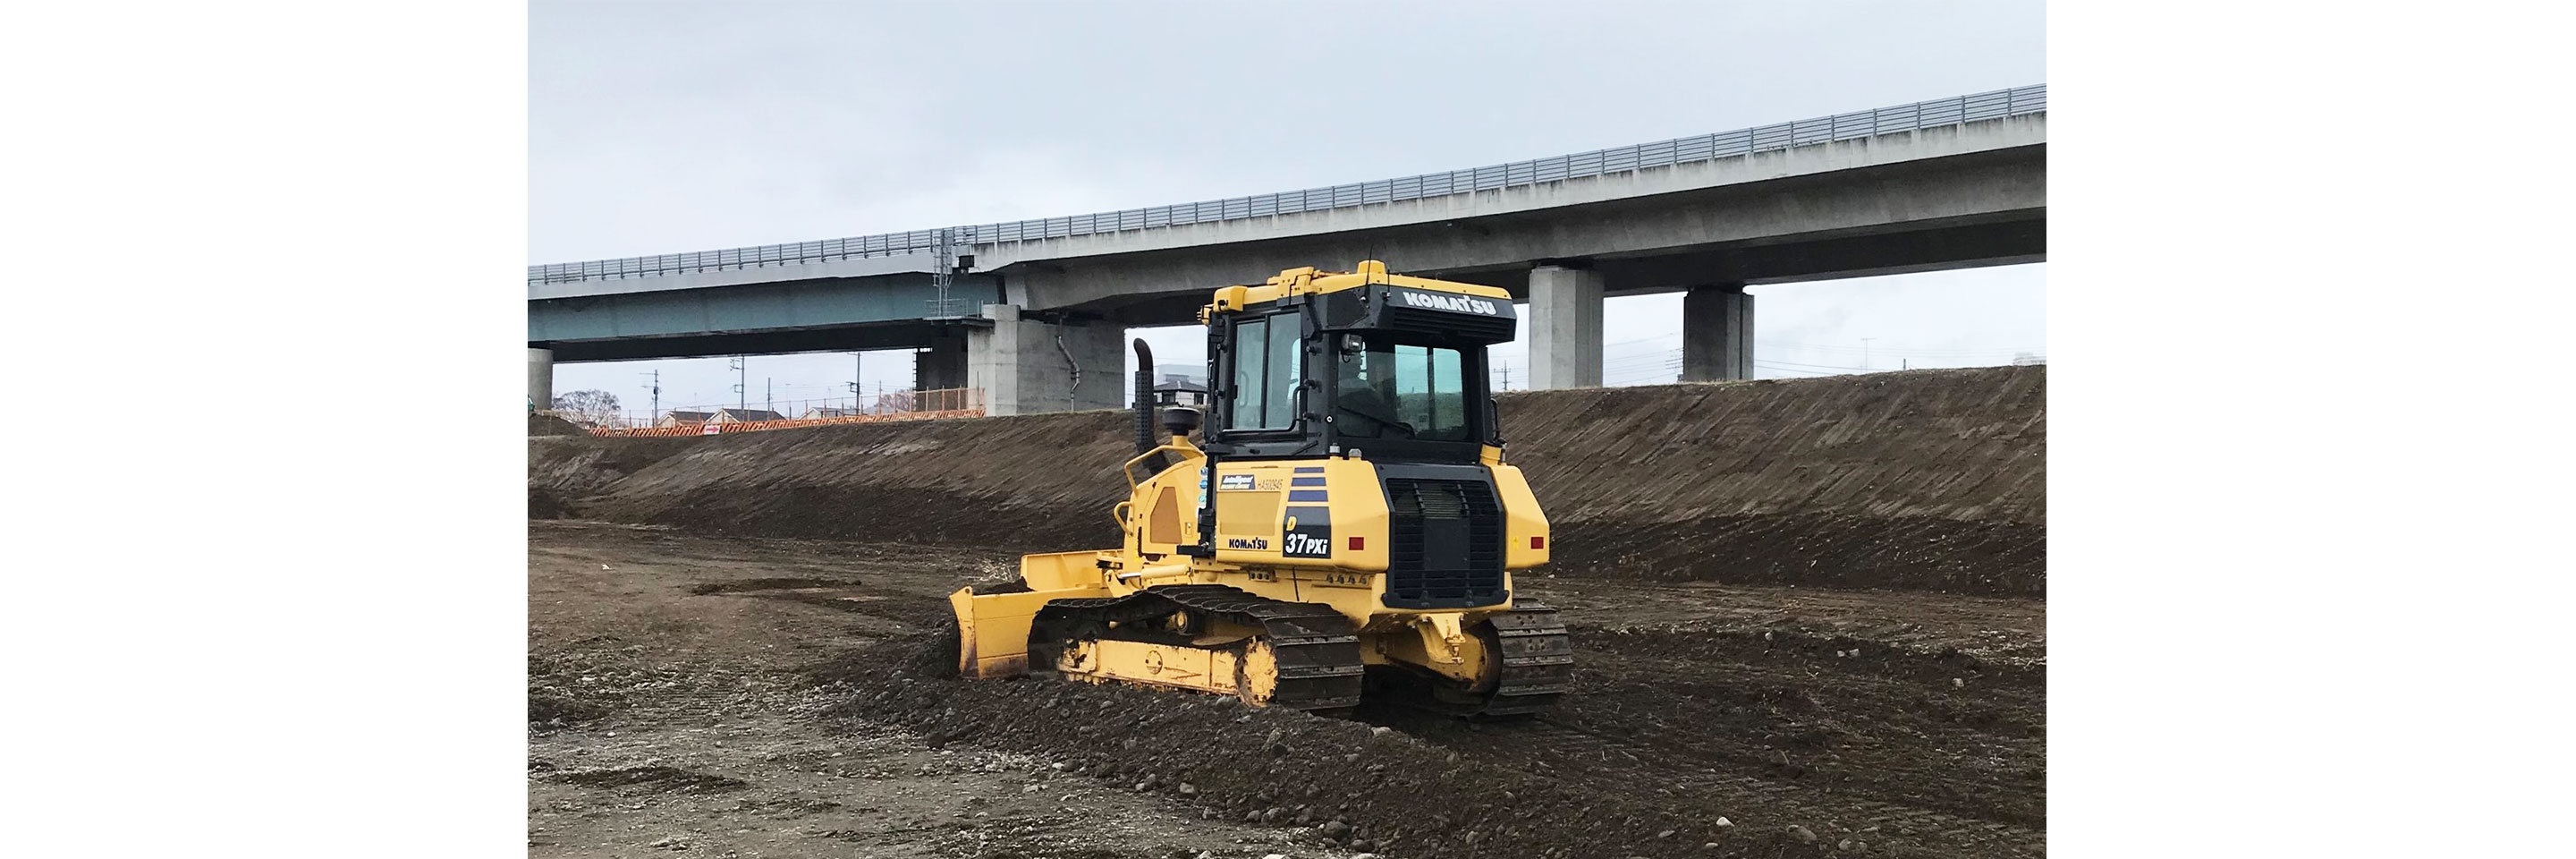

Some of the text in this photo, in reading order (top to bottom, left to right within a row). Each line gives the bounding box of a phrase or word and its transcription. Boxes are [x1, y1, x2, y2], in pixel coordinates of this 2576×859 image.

[1402, 292, 1496, 315] KOMATSU
[1286, 516, 1297, 532] D
[1228, 537, 1268, 549] KOMATSU
[1285, 533, 1328, 554] 37PXi
